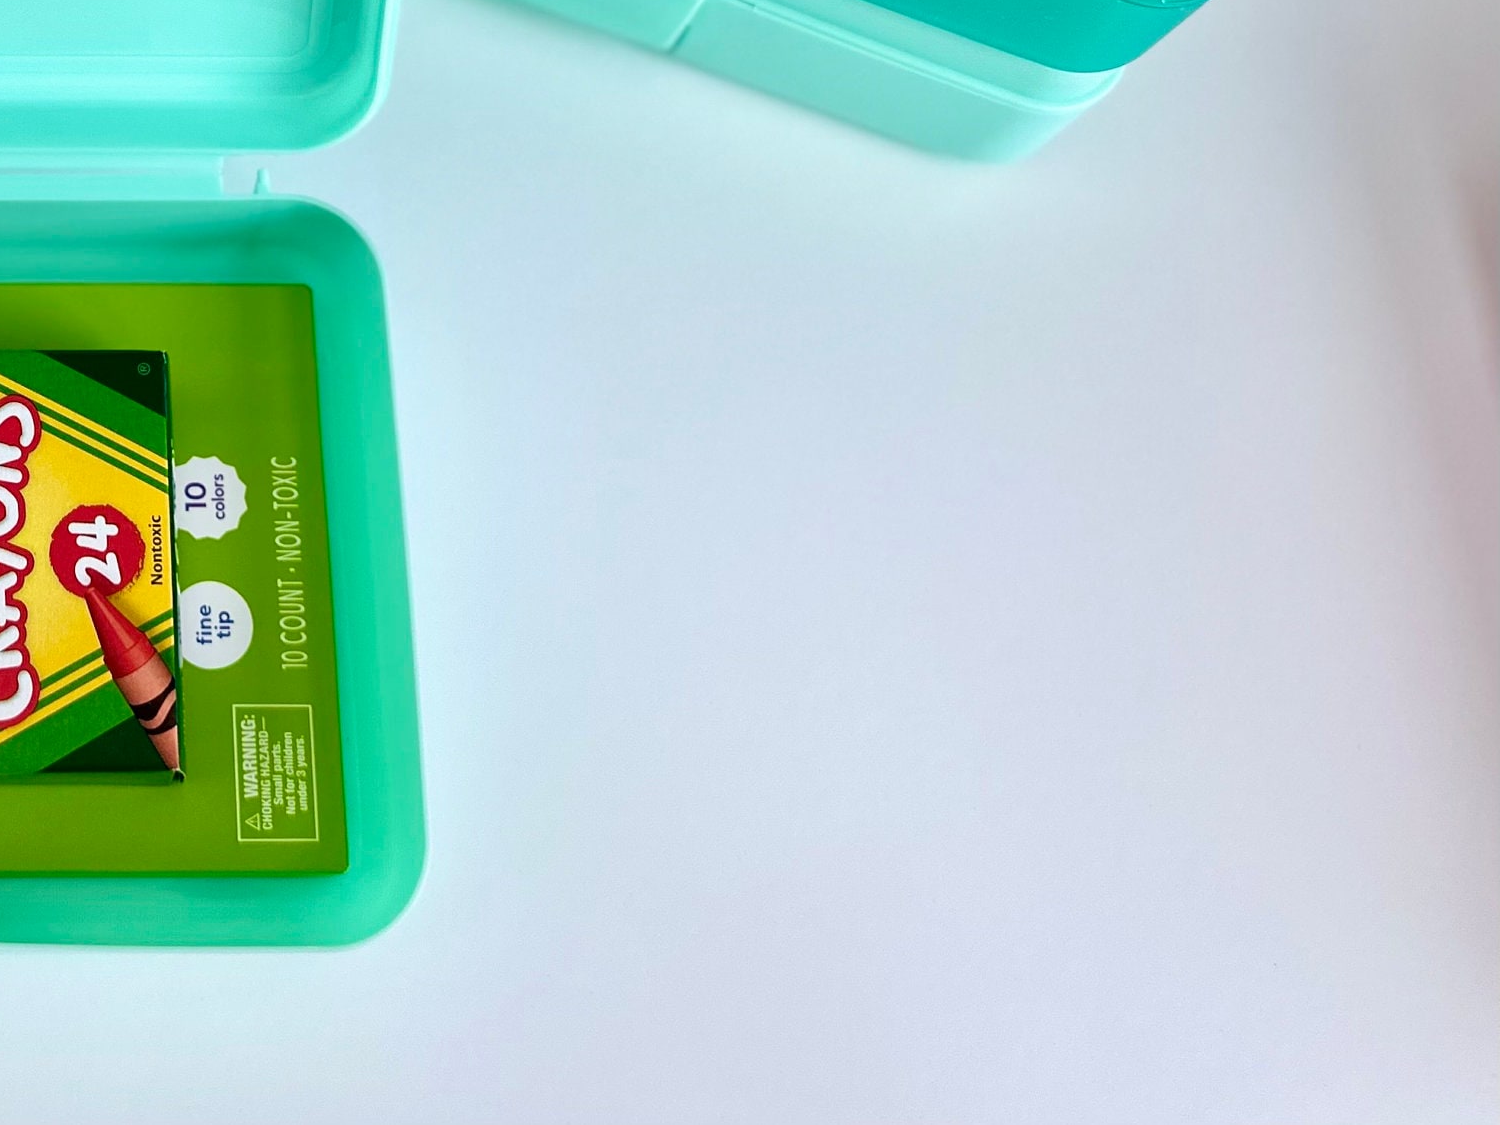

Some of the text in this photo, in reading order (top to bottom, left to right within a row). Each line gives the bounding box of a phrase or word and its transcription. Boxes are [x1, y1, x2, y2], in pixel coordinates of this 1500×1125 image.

[184, 482, 207, 512] 10
[211, 473, 225, 520] colors
[68, 515, 122, 587] 24
[148, 514, 162, 586] Nontoxic
[270, 456, 309, 671] 10 COUNT NON-TOXIC
[196, 604, 213, 646] fine
[214, 610, 234, 639] tip
[240, 714, 259, 798] WARNING:
[271, 741, 284, 805] Small parts.
[283, 731, 296, 815] Not for children
[295, 735, 308, 811] under 3 years.
[260, 778, 273, 830] CHOKING
